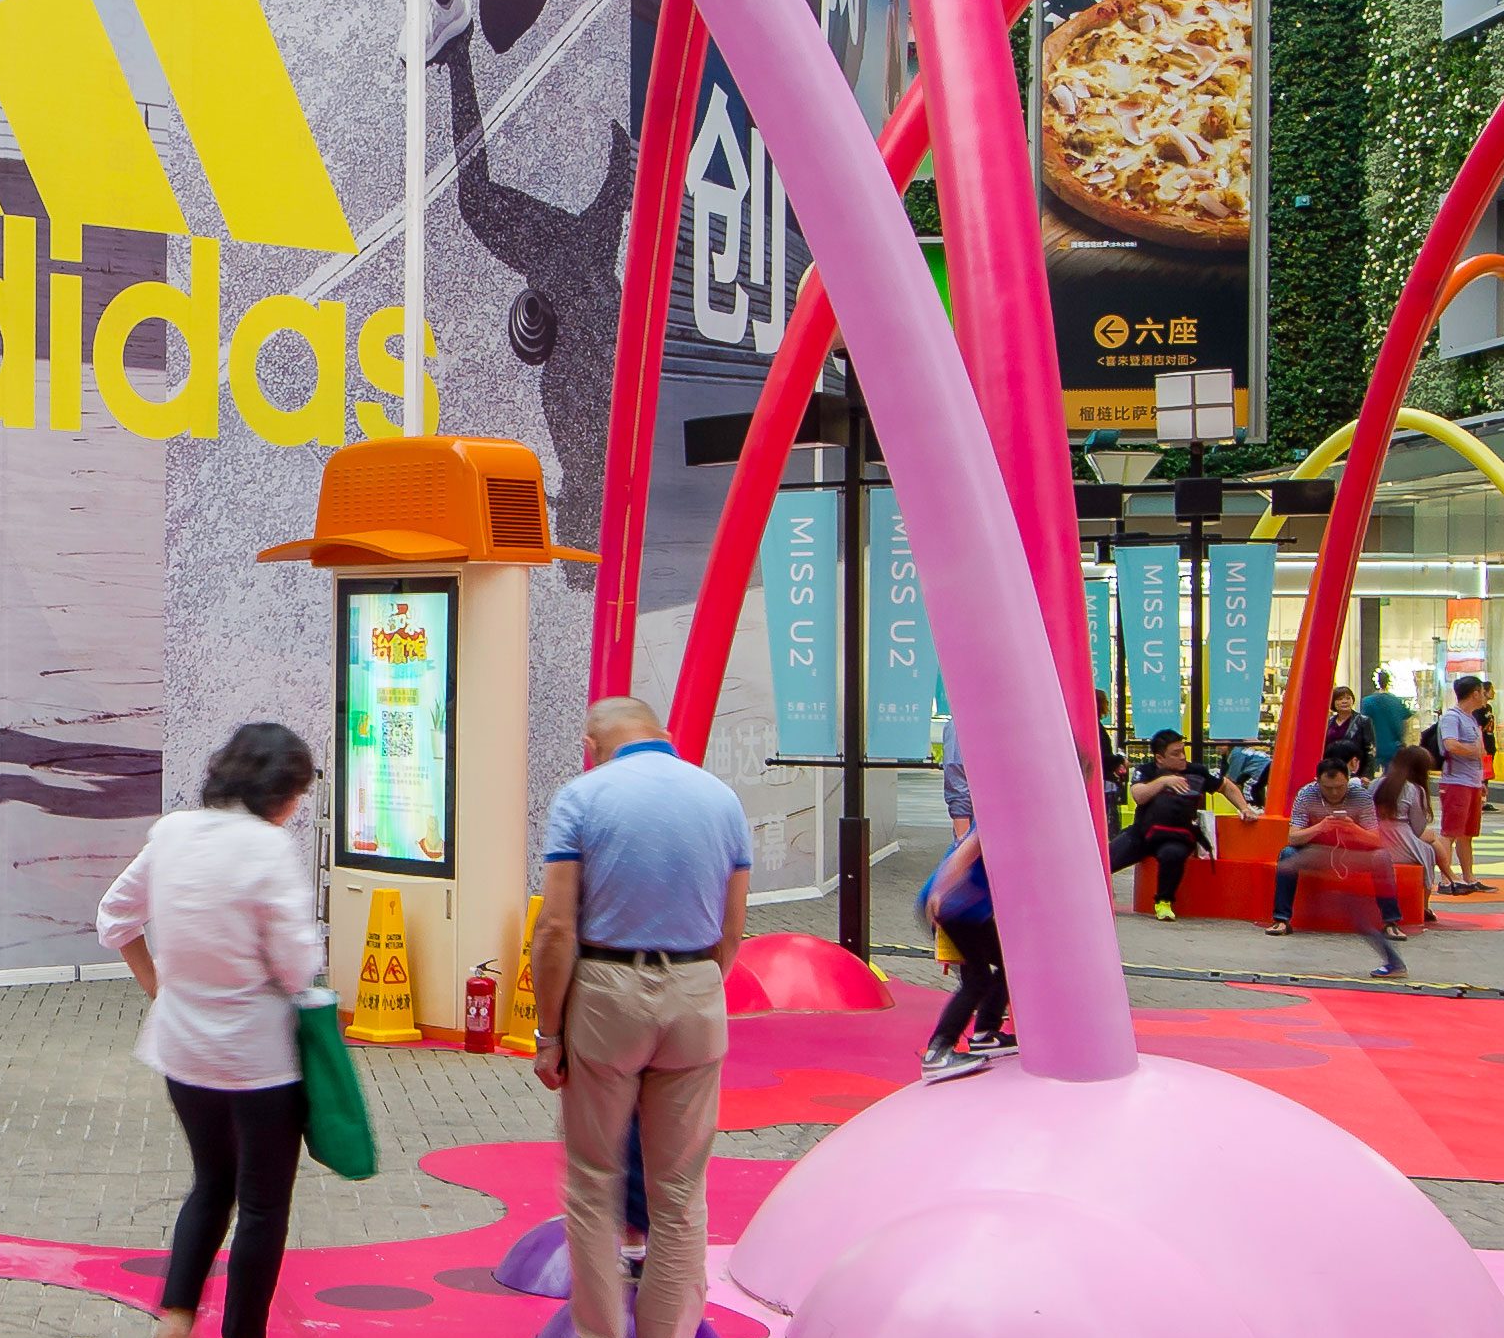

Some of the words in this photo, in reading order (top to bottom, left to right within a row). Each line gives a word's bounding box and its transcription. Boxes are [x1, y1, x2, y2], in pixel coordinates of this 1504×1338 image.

[1135, 317, 1198, 345] 六座
[789, 517, 815, 605] MISS
[891, 515, 917, 605] MISS
[1143, 564, 1164, 630] MISS
[1225, 561, 1247, 628] MISS
[789, 620, 815, 668] U2
[889, 620, 916, 668] U2
[1143, 639, 1164, 675] U2
[1225, 638, 1247, 674] U2
[1449, 620, 1480, 650] LEGO
[386, 933, 402, 941] CAUTION
